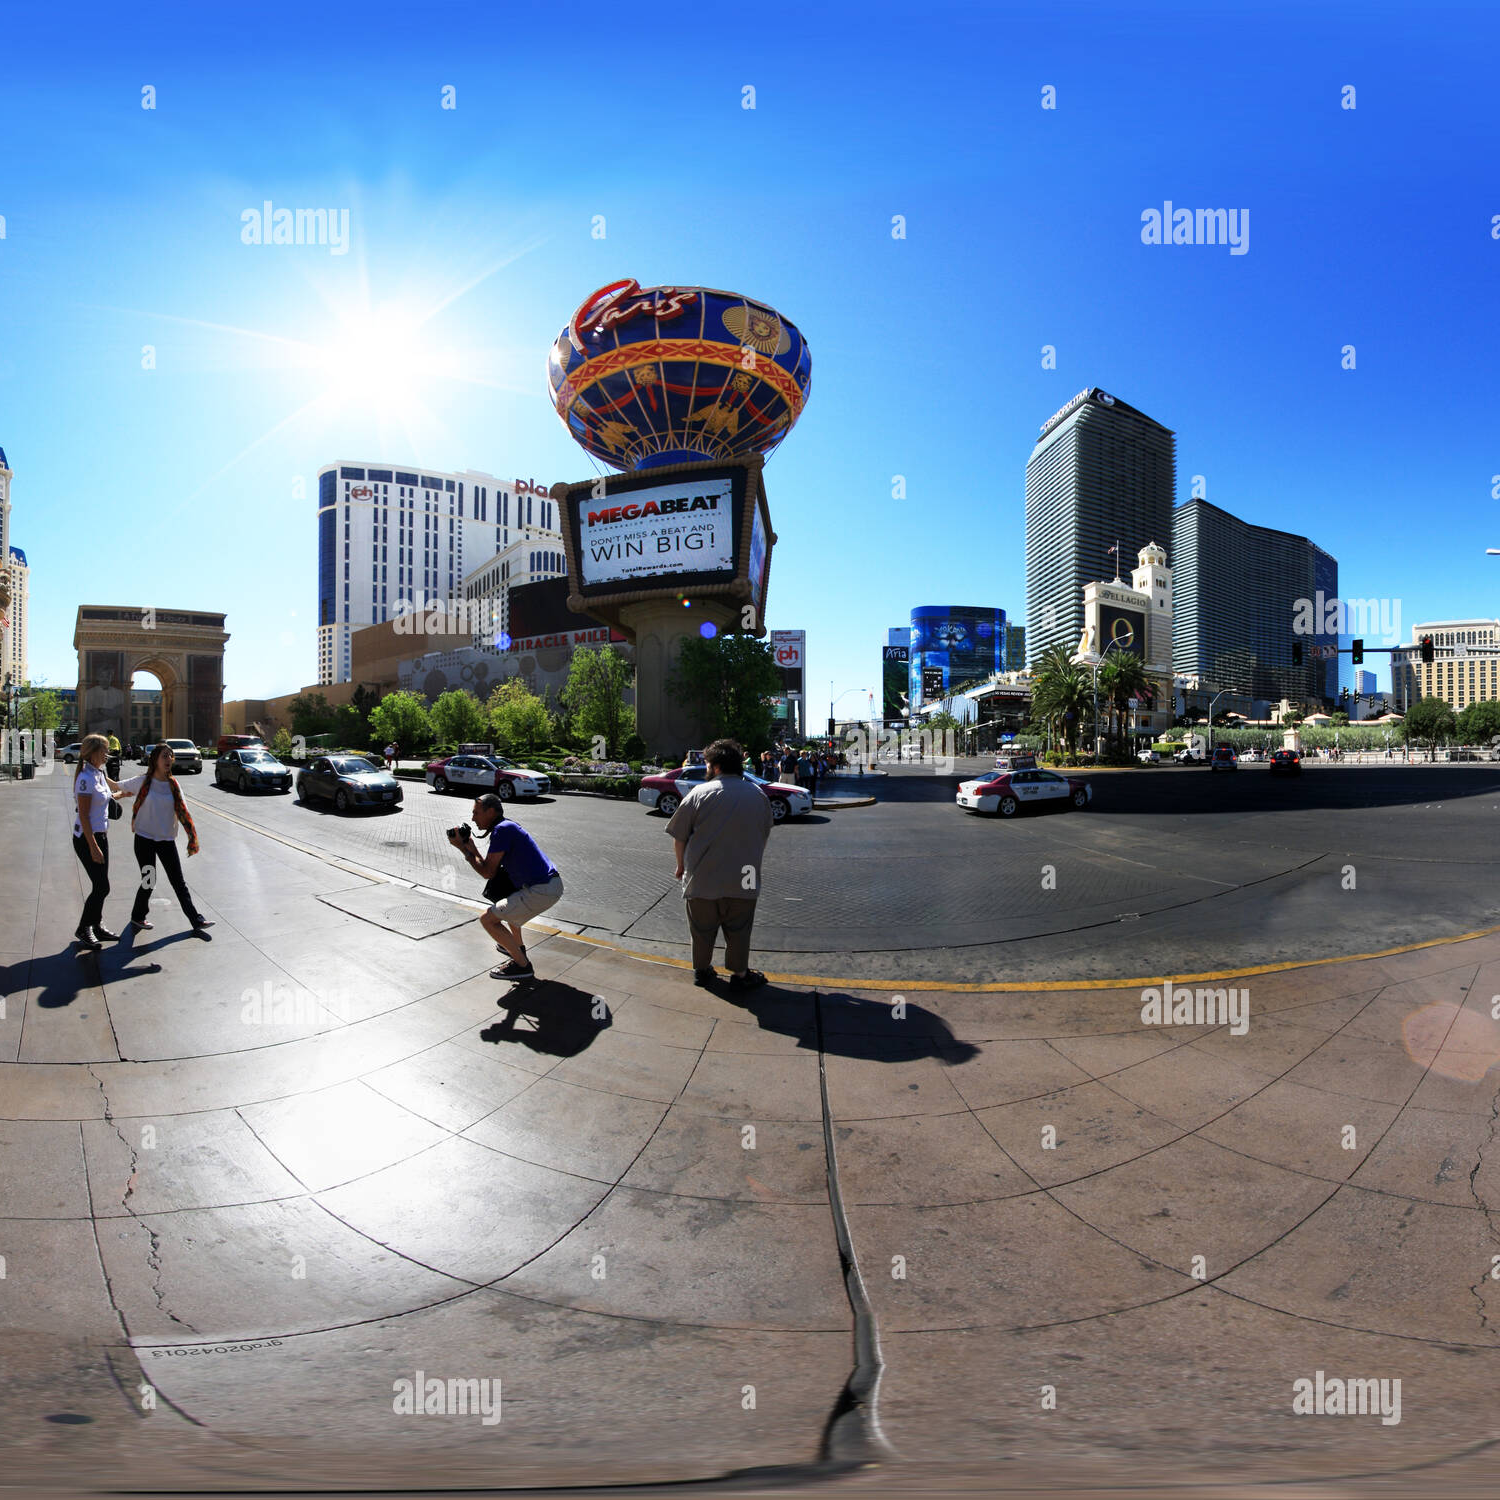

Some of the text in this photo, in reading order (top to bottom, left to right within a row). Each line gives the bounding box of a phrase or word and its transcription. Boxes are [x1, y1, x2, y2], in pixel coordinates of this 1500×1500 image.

[568, 277, 699, 356] Paris
[587, 494, 722, 528] MEGABEAT
[590, 534, 621, 547] DON'T
[624, 531, 648, 541] MISS
[651, 529, 658, 538] A
[660, 525, 687, 537] BEAT
[691, 523, 715, 532] AND
[591, 532, 715, 563] WIN BIG!
[621, 561, 684, 574] TotalRewards.com
[510, 628, 608, 652] MIRACLE MILE
[885, 647, 907, 659] Aria
[79, 779, 87, 791] 3
